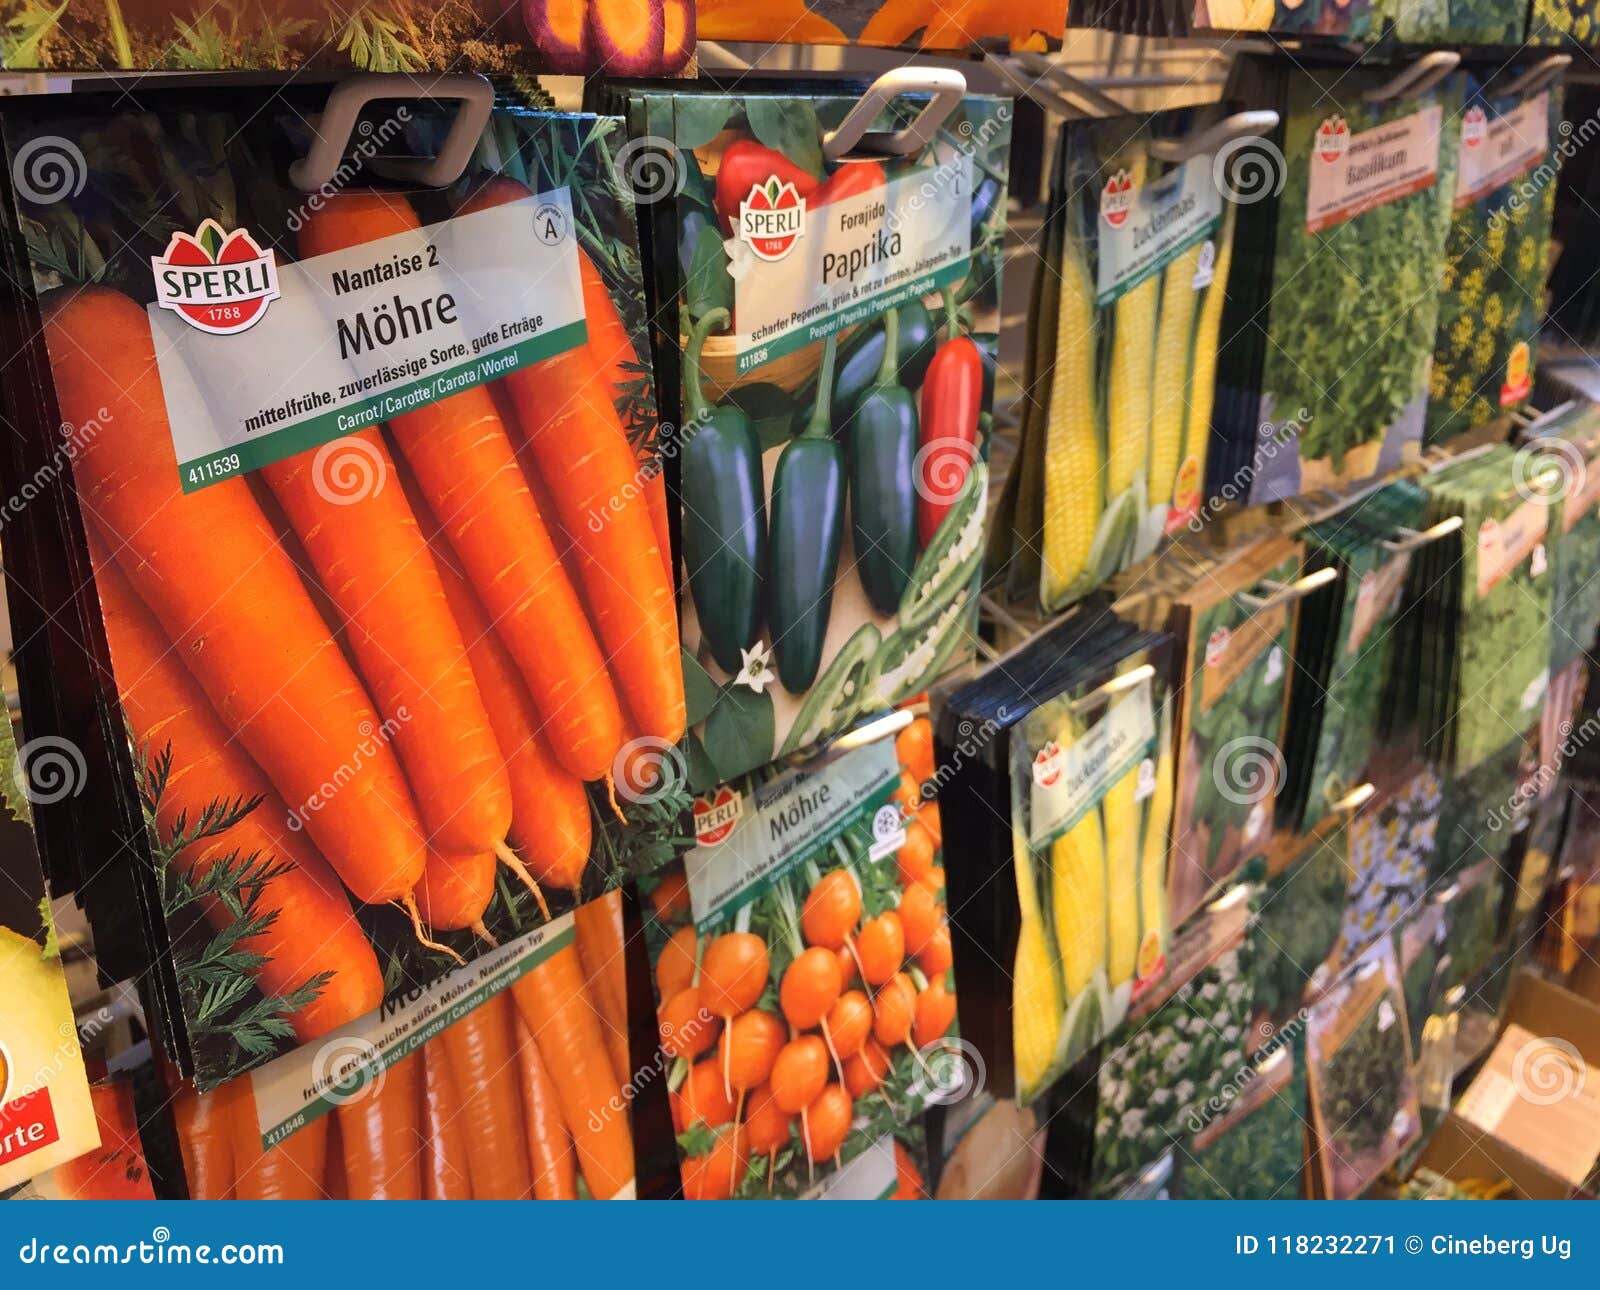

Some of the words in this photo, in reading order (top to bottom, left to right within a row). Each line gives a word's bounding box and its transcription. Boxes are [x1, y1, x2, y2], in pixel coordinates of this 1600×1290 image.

[545, 218, 558, 239] A
[745, 208, 801, 234] SPERLI
[840, 202, 886, 232] Forajido
[331, 254, 422, 296] Nantaise
[426, 244, 439, 268] 2
[822, 229, 901, 285] Paprika
[163, 262, 270, 299] SPERLI
[208, 306, 241, 321] 1788
[336, 293, 458, 360] Möhre
[751, 316, 789, 342] scharfer
[244, 390, 336, 433] mittelfrühe,
[338, 357, 428, 398] zuverlässige
[430, 342, 469, 366] Sorte,
[472, 331, 499, 354] gute
[501, 314, 543, 340] Erträge
[188, 453, 241, 485] 411539
[697, 799, 738, 831] PERLI
[769, 783, 830, 841] Möhre
[0, 1122, 45, 1156] rte
